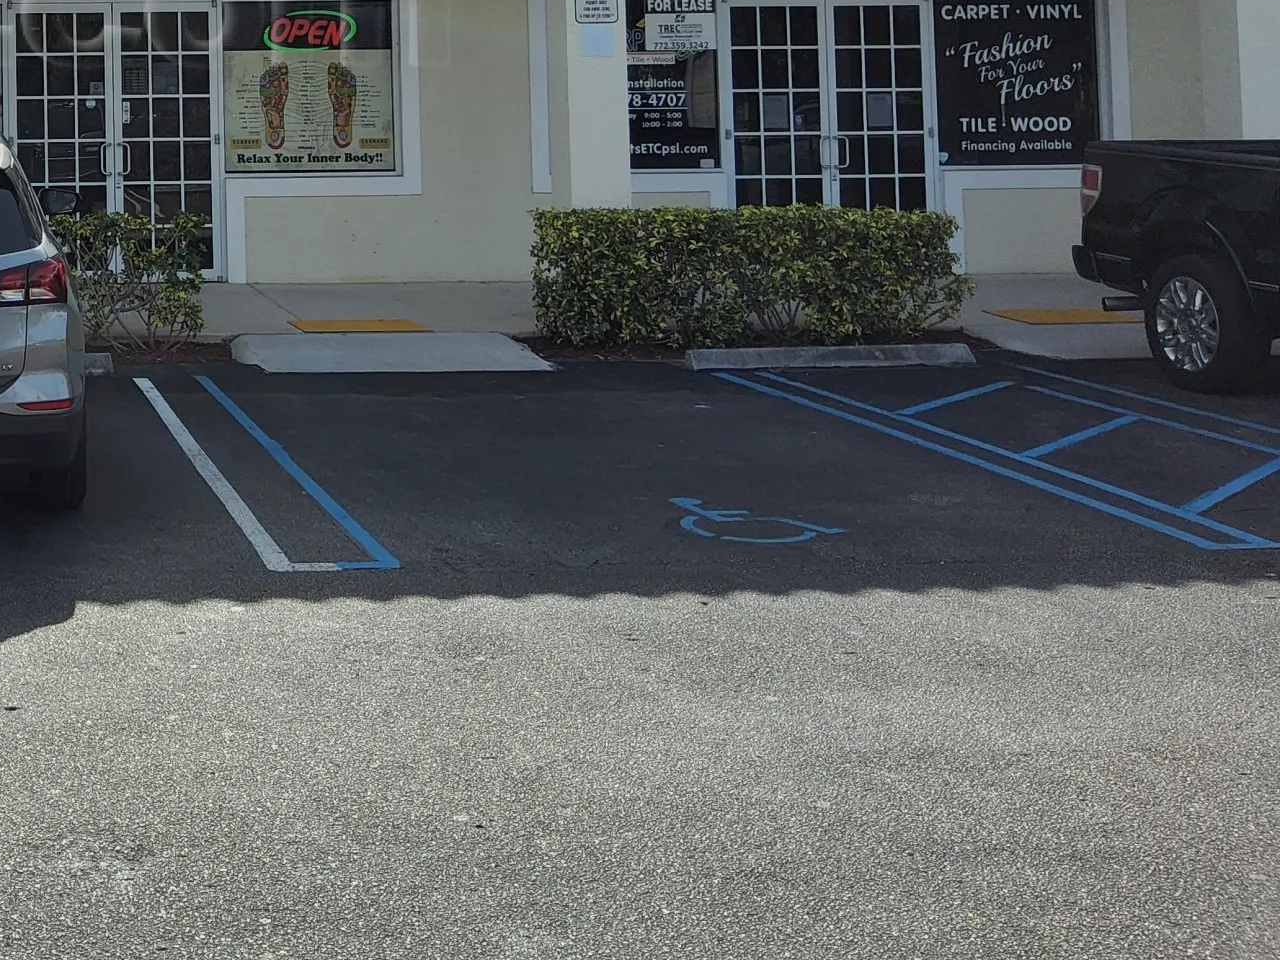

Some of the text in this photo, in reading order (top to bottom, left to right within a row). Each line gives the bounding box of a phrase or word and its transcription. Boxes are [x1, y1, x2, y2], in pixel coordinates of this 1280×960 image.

[940, 4, 1083, 21] CARPET VINYL
[269, 17, 348, 46] OPEN
[657, 24, 681, 34] TREC
[653, 41, 709, 50] 772.359.3242
[977, 57, 1046, 83] For Your
[627, 77, 685, 88] nstallation
[626, 93, 686, 107] 78-4707
[959, 116, 1072, 133] TILE WOOD
[629, 142, 708, 157] tsETCpsl.com
[961, 139, 1073, 153] Financing Available
[236, 151, 383, 164] Relax Your Inner Body!!
